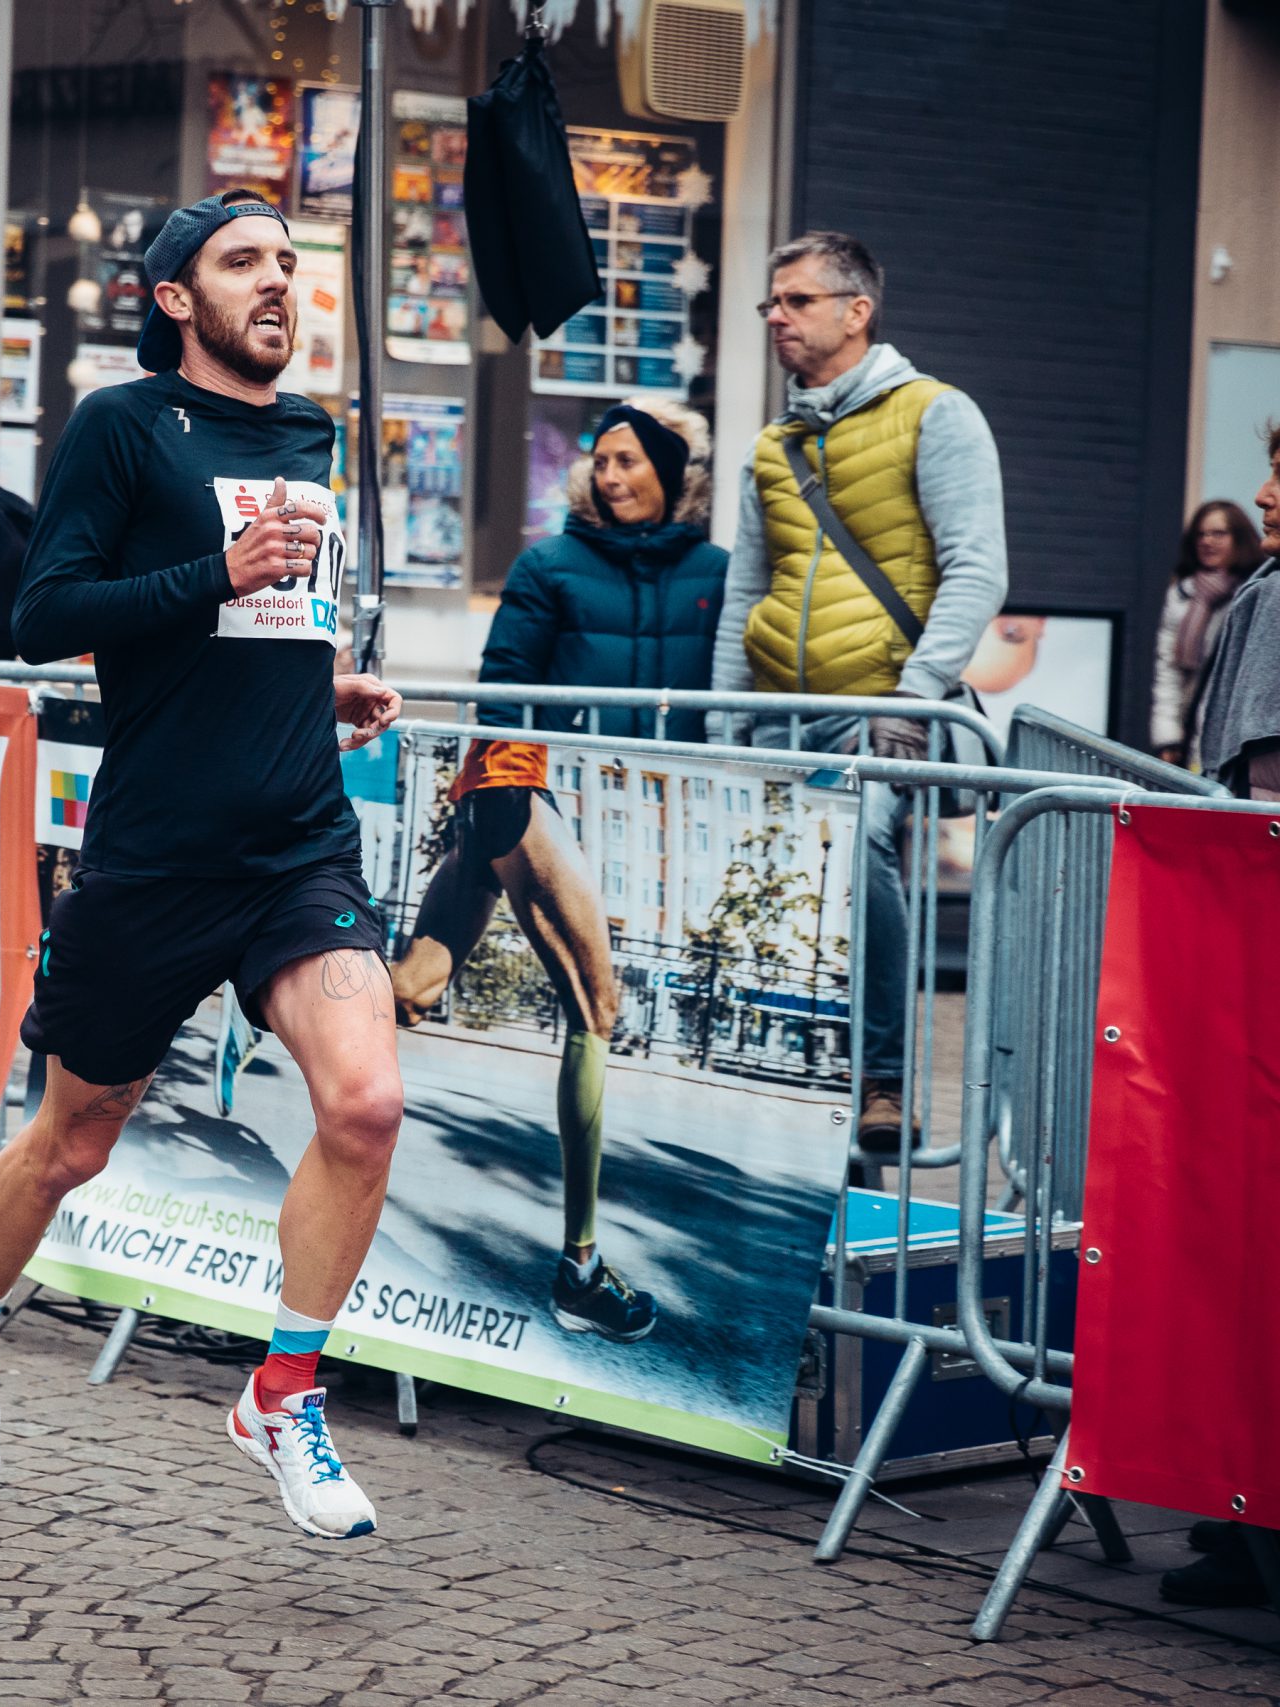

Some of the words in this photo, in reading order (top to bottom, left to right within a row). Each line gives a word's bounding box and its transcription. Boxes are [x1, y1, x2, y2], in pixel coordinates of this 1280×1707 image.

[254, 612, 306, 630] Airport
[89, 1220, 187, 1267] NICHT
[185, 1243, 258, 1287] ERST
[372, 1284, 530, 1351] SCHMERZT
